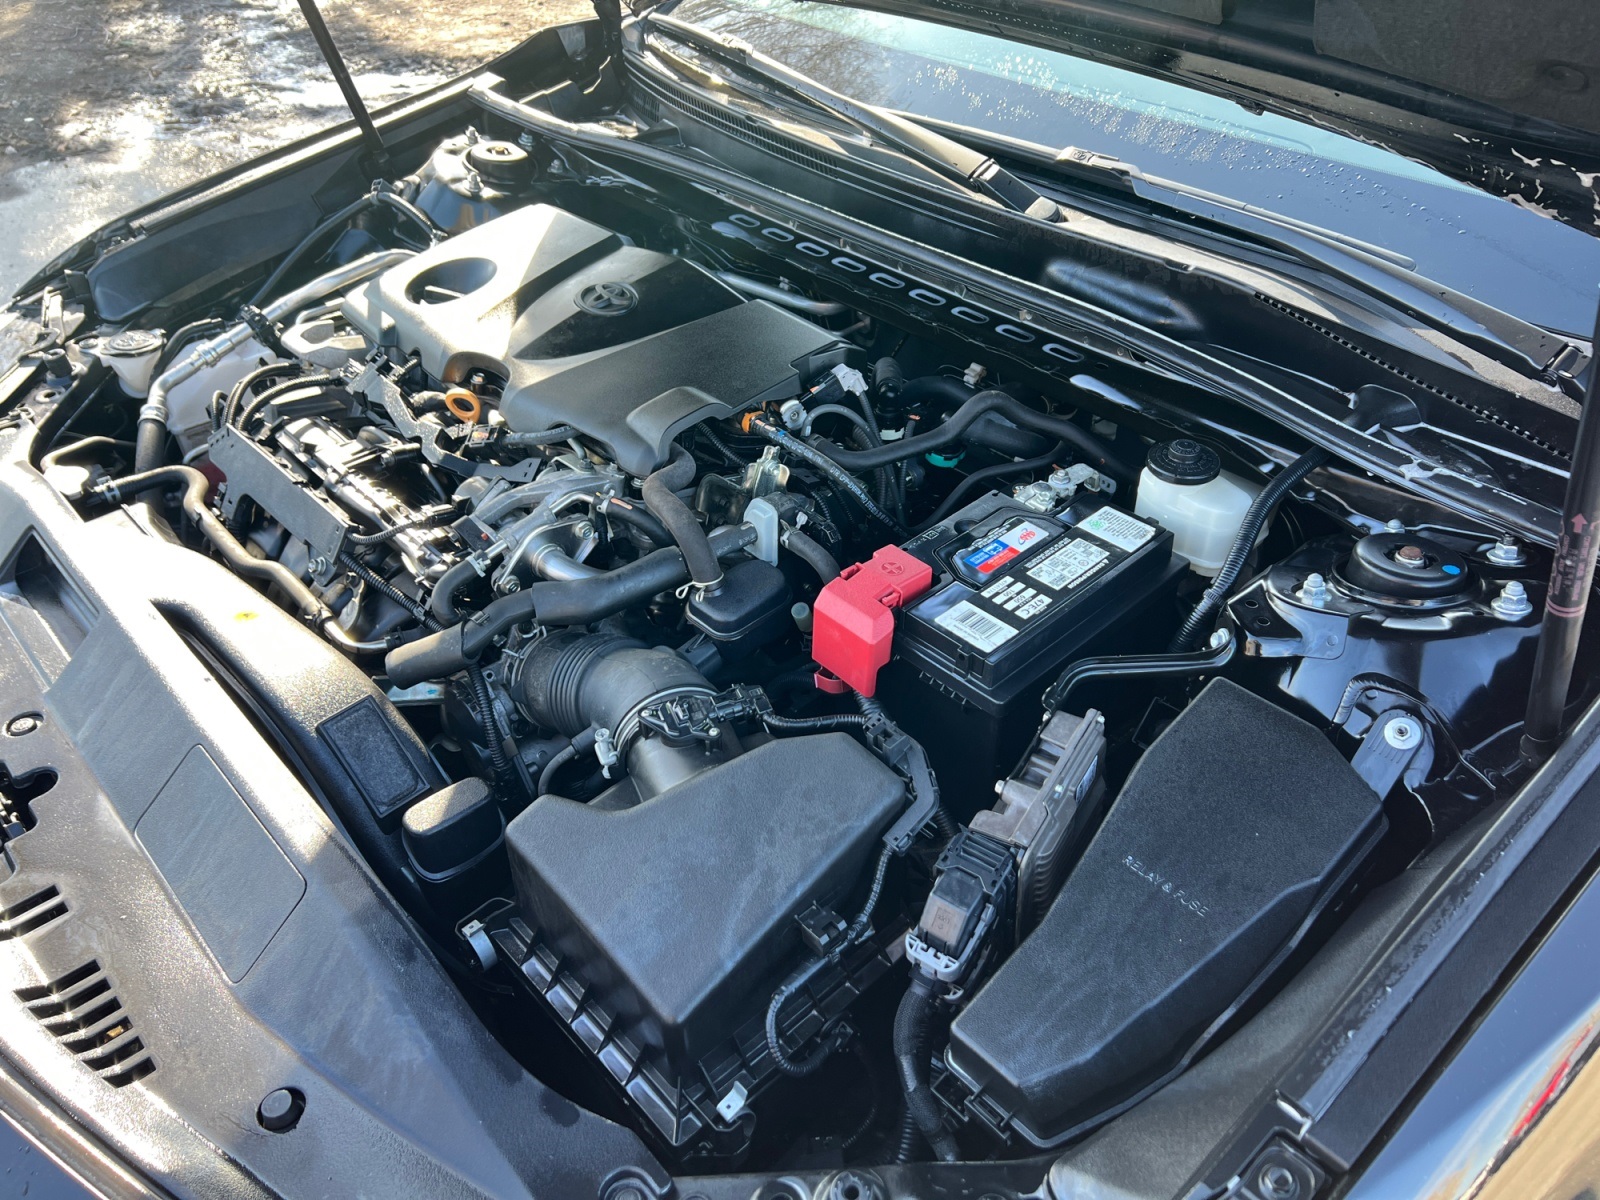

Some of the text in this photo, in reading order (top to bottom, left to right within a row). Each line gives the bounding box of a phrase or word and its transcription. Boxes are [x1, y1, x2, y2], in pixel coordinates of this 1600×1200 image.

[1020, 598, 1045, 616] 47E-C
[1122, 855, 1209, 917] RELAY & FUSE
